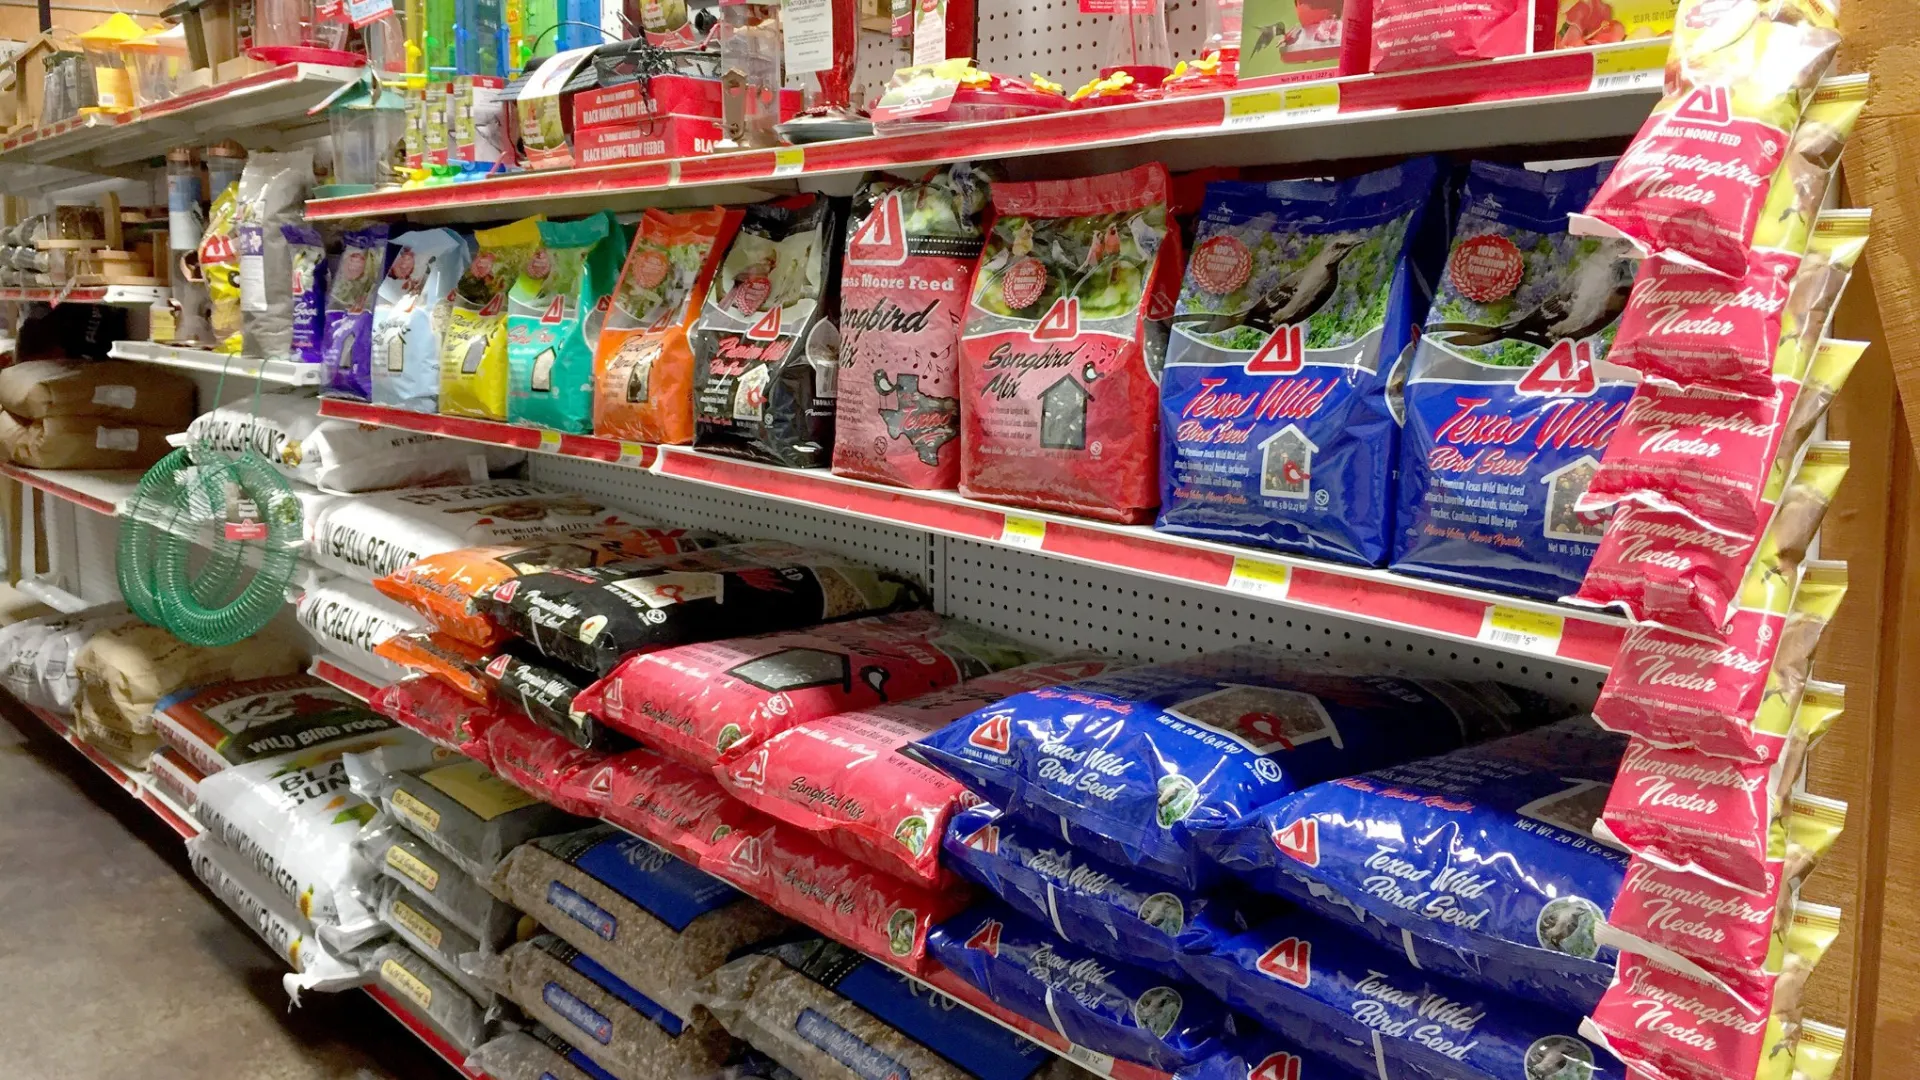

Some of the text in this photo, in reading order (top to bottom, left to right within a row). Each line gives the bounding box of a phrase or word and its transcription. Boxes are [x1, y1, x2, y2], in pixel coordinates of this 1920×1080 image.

[583, 102, 637, 125] BLACK HANGING TRAY
[583, 140, 666, 163] BLACK HANGING TRAY FEEDER
[1683, 127, 1742, 147] MOORE FEED
[1617, 140, 1770, 188] Hummingbird
[1635, 166, 1716, 206] Nectar
[1467, 263, 1502, 277] QUALITY
[1468, 255, 1507, 269] PREMIUM
[861, 273, 955, 291] Moore Feed
[1630, 278, 1785, 312] Hummingbird
[1646, 304, 1734, 336] Nectar
[982, 341, 1088, 379] Songbird
[980, 372, 1022, 402] Mix
[1182, 377, 1340, 421] Texas Wild
[1177, 419, 1256, 444] Bird Seed
[1434, 397, 1540, 446] Texas
[1621, 396, 1780, 438] Hummingbird
[391, 438, 405, 448] NET
[1638, 425, 1721, 458] Nectar
[1428, 446, 1538, 476] Bird Seed
[1440, 478, 1465, 490] Premium
[1465, 481, 1481, 492] Texas
[1482, 482, 1496, 493] Wild
[1496, 483, 1509, 494] Bird
[1510, 485, 1525, 496] Seed
[1465, 494, 1480, 506] local
[1498, 499, 1528, 515] including
[492, 525, 543, 537] PREMIUM
[1451, 510, 1477, 523] Cardinals
[1478, 513, 1489, 524] and
[1490, 514, 1504, 526] Blue
[1505, 516, 1518, 530] Jays
[1606, 505, 1749, 559] Hummingbird
[1548, 543, 1559, 553] Net
[1569, 546, 1574, 556] 5
[1574, 545, 1581, 556] lb
[1619, 534, 1692, 571] Nectar
[305, 597, 320, 631] IN
[321, 601, 354, 645] SHELL
[1620, 627, 1769, 675] Hummingbird
[1635, 655, 1717, 693] Nectar
[248, 718, 389, 753] WILD BIRD FOOD
[963, 746, 983, 759] THOMAS
[1156, 714, 1244, 754] Net Wt. 20 lb (9.07 kg)
[1038, 738, 1135, 777] Texas Wild
[1620, 743, 1765, 793] Hummingbird
[789, 776, 865, 820] Songbird Mix
[1037, 758, 1127, 801] Bird Seed
[1636, 776, 1719, 814] Nectar
[1513, 819, 1538, 832] Net
[1537, 825, 1553, 839] Wt.
[1555, 834, 1571, 844] 20
[1575, 837, 1588, 848] lb
[1028, 848, 1114, 895] Texas Wild
[1364, 843, 1497, 899] Texas Wild
[1362, 876, 1491, 931] Bird Seed
[1625, 862, 1775, 924] Hummingbird
[1643, 899, 1726, 944] Nectar
[1029, 941, 1116, 986] Texas Wild
[1066, 981, 1108, 1011] Seed
[1353, 969, 1486, 1032] Texas Wild
[1625, 965, 1767, 1035] Hummingbird
[1351, 998, 1470, 1062] Bird Seed
[1632, 1000, 1718, 1051] Nectar
